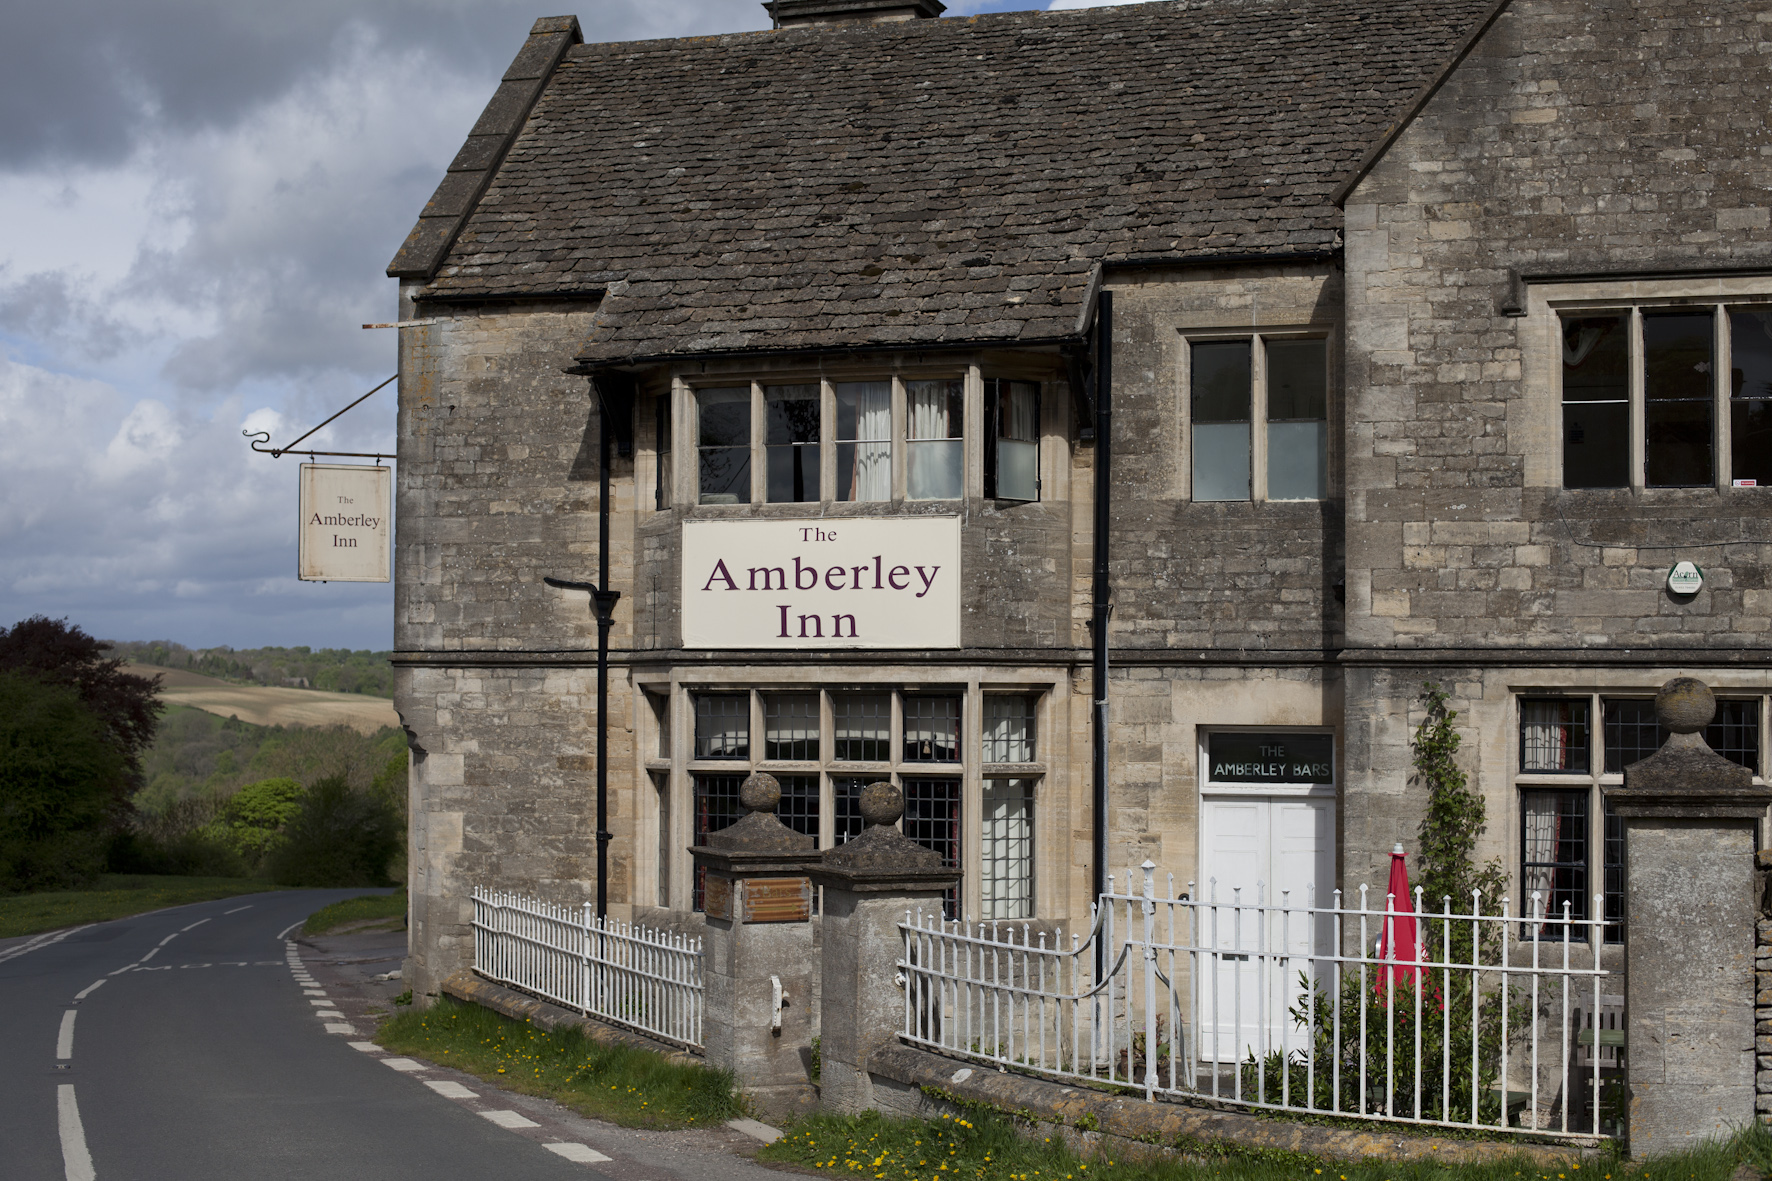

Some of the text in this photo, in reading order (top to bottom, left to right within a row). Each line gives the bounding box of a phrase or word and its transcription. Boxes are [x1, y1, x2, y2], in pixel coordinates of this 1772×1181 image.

[337, 496, 354, 504] The
[309, 512, 380, 529] Amberley
[333, 534, 358, 548] Inn
[799, 527, 837, 542] The
[701, 555, 941, 598] Amberley
[776, 605, 860, 638] Inn
[1259, 745, 1285, 757] THE
[1214, 763, 1330, 776] AMBERLEY BARS
[762, 886, 792, 898] Bars
